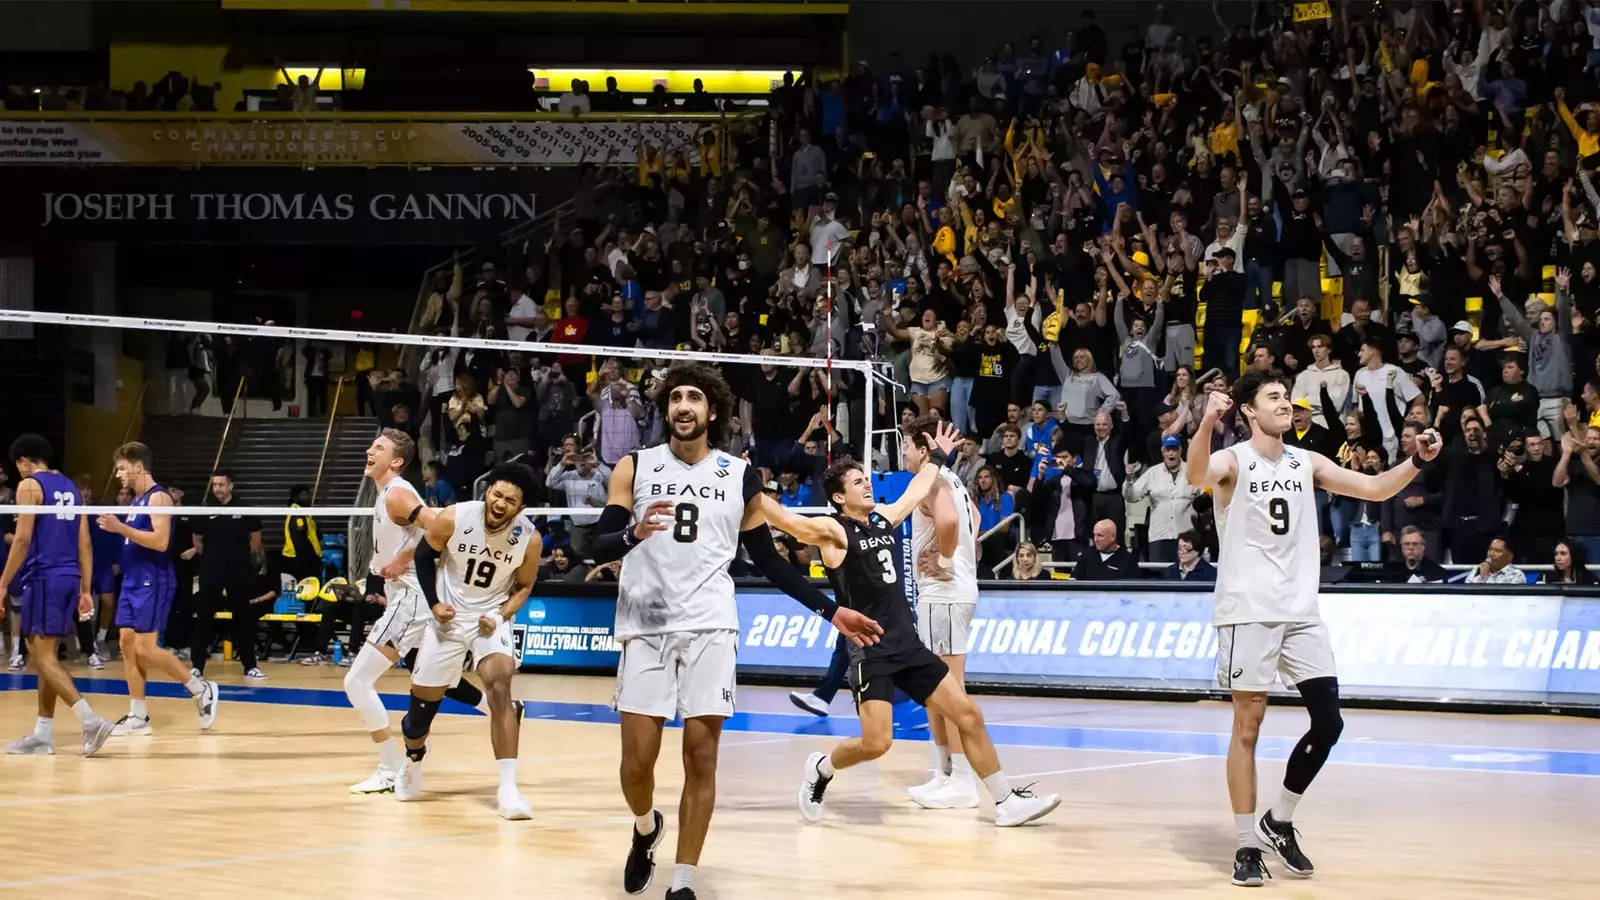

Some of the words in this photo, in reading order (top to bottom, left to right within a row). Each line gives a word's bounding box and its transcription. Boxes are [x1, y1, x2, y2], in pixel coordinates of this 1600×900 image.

[16, 126, 33, 134] the
[36, 126, 64, 134] most
[31, 138, 48, 147] Big
[52, 138, 78, 146] West
[153, 129, 359, 141] COMMISSIONER'S
[375, 129, 417, 141] CUP
[461, 126, 506, 158] 2005-06
[485, 126, 531, 158] 2008-09
[508, 125, 553, 158] 2010-11
[532, 126, 575, 158] 2011-12
[50, 150, 75, 158] each
[191, 141, 388, 152] CHAMPIONSHIPS
[41, 192, 175, 226] JOSEPH
[190, 193, 354, 220] THOMAS
[369, 193, 538, 221] GANNON
[650, 483, 726, 502] BEACH
[1249, 479, 1303, 493] BEACH
[673, 502, 699, 543] 8
[1268, 497, 1290, 536] 9
[457, 543, 513, 565] BEACH
[877, 548, 898, 584] 3
[463, 558, 497, 589] 19
[526, 633, 588, 651] VOLLEYBALL
[557, 626, 580, 634] NATIONAL
[581, 626, 609, 635] COLLEGIATE
[744, 613, 823, 649] 2024
